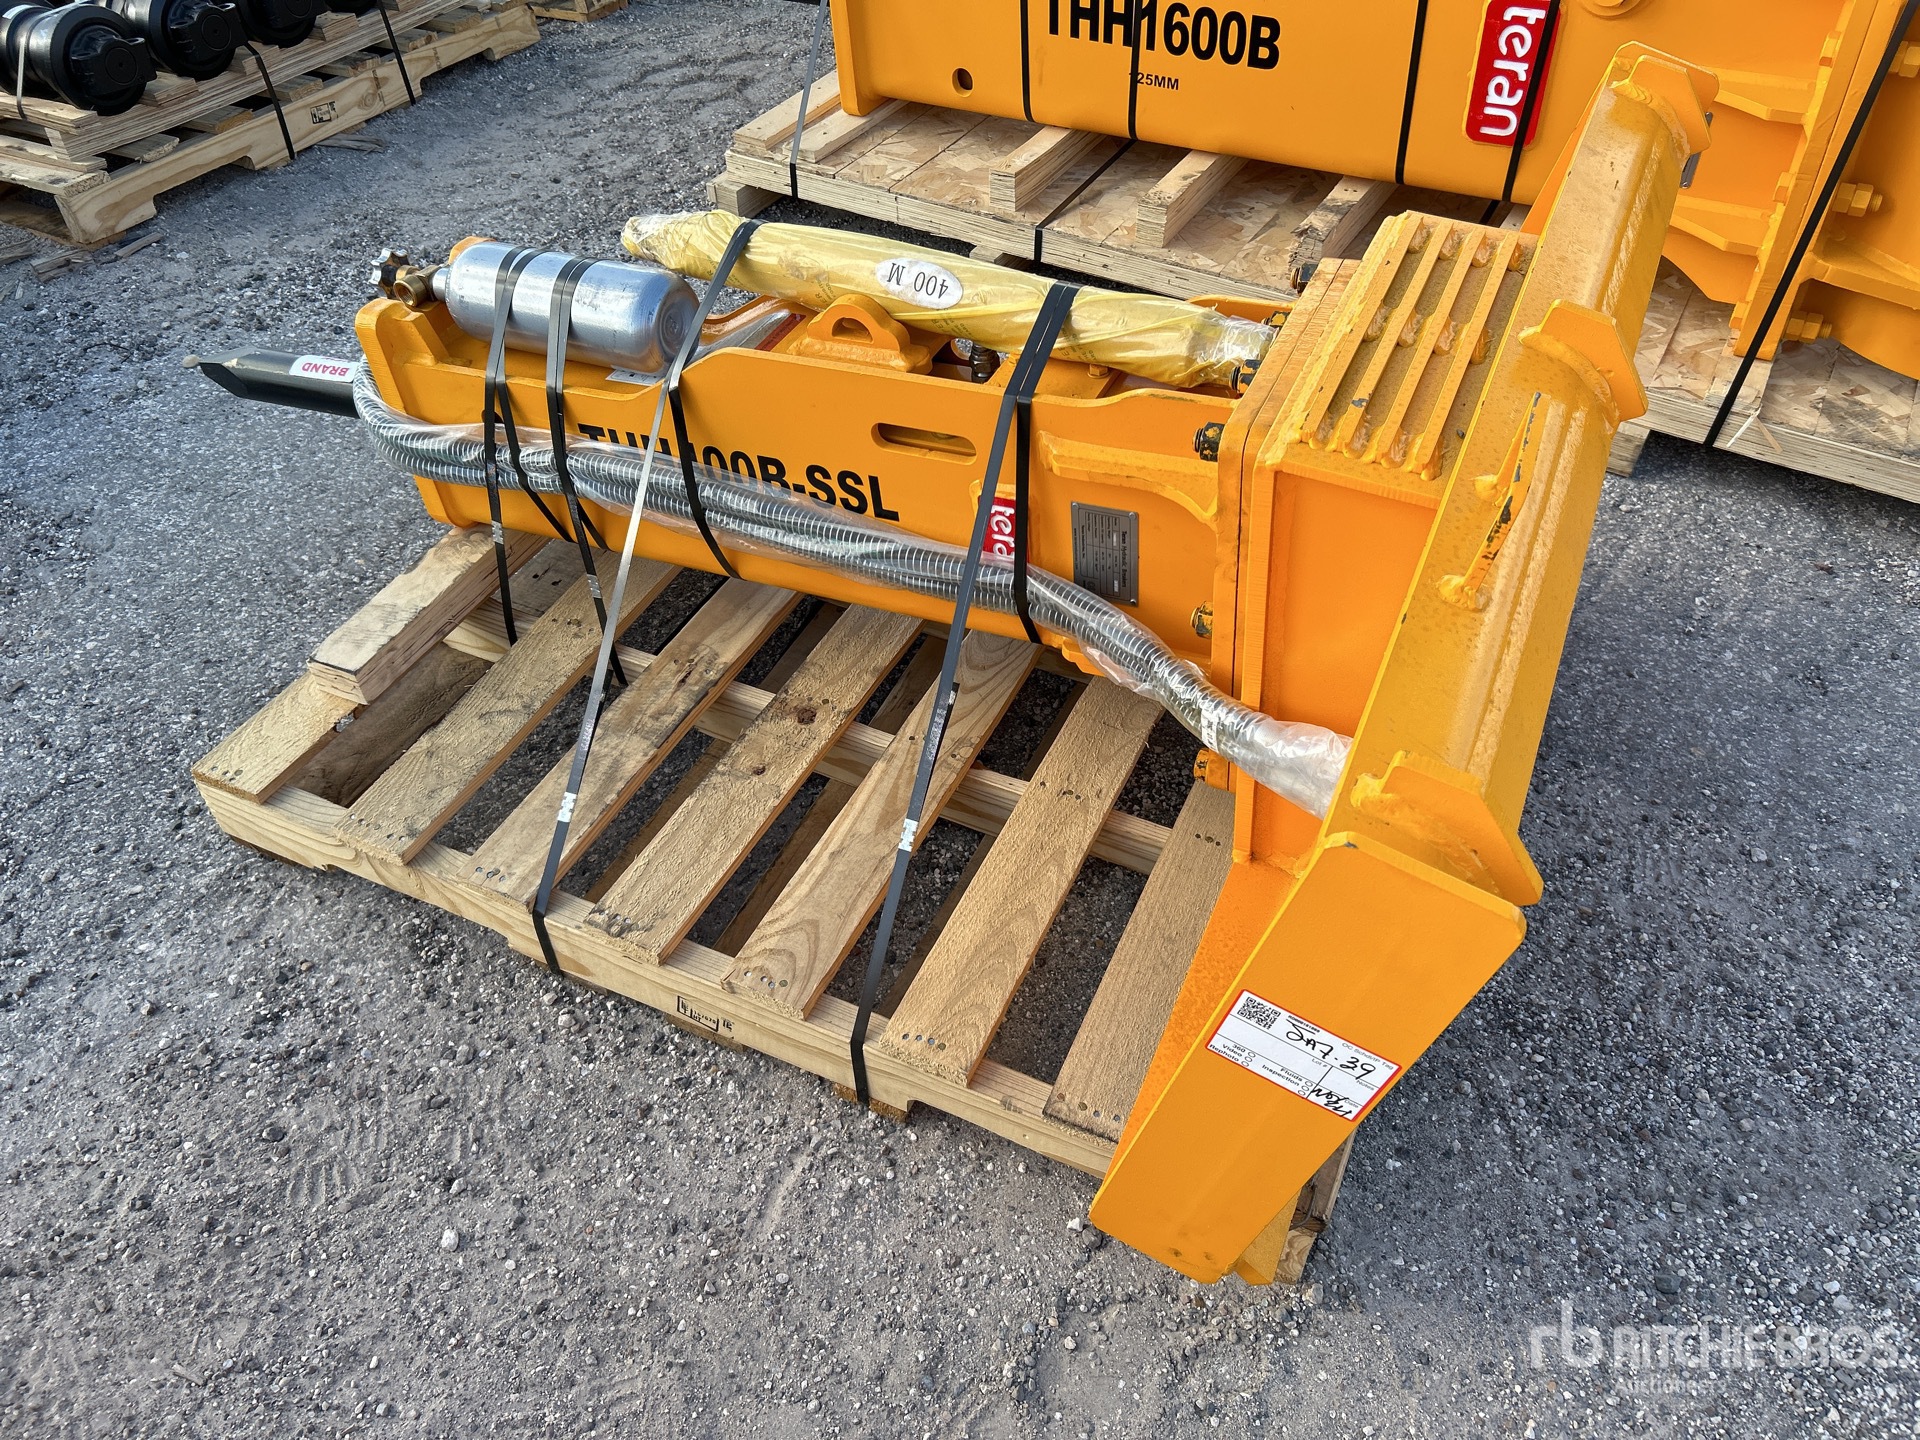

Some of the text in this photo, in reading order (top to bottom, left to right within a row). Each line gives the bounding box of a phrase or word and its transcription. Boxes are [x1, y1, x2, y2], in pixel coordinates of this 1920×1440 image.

[1479, 6, 1546, 137] teran
[1128, 72, 1179, 91] 25MM
[887, 262, 950, 299] 400 M
[301, 362, 350, 377] BRAND
[1209, 1044, 1240, 1062] Rephoto
[1222, 1044, 1242, 1057] Video
[1232, 1044, 1246, 1053] 360
[1262, 1064, 1300, 1086] Inspection
[1280, 1068, 1302, 1082] Fluids
